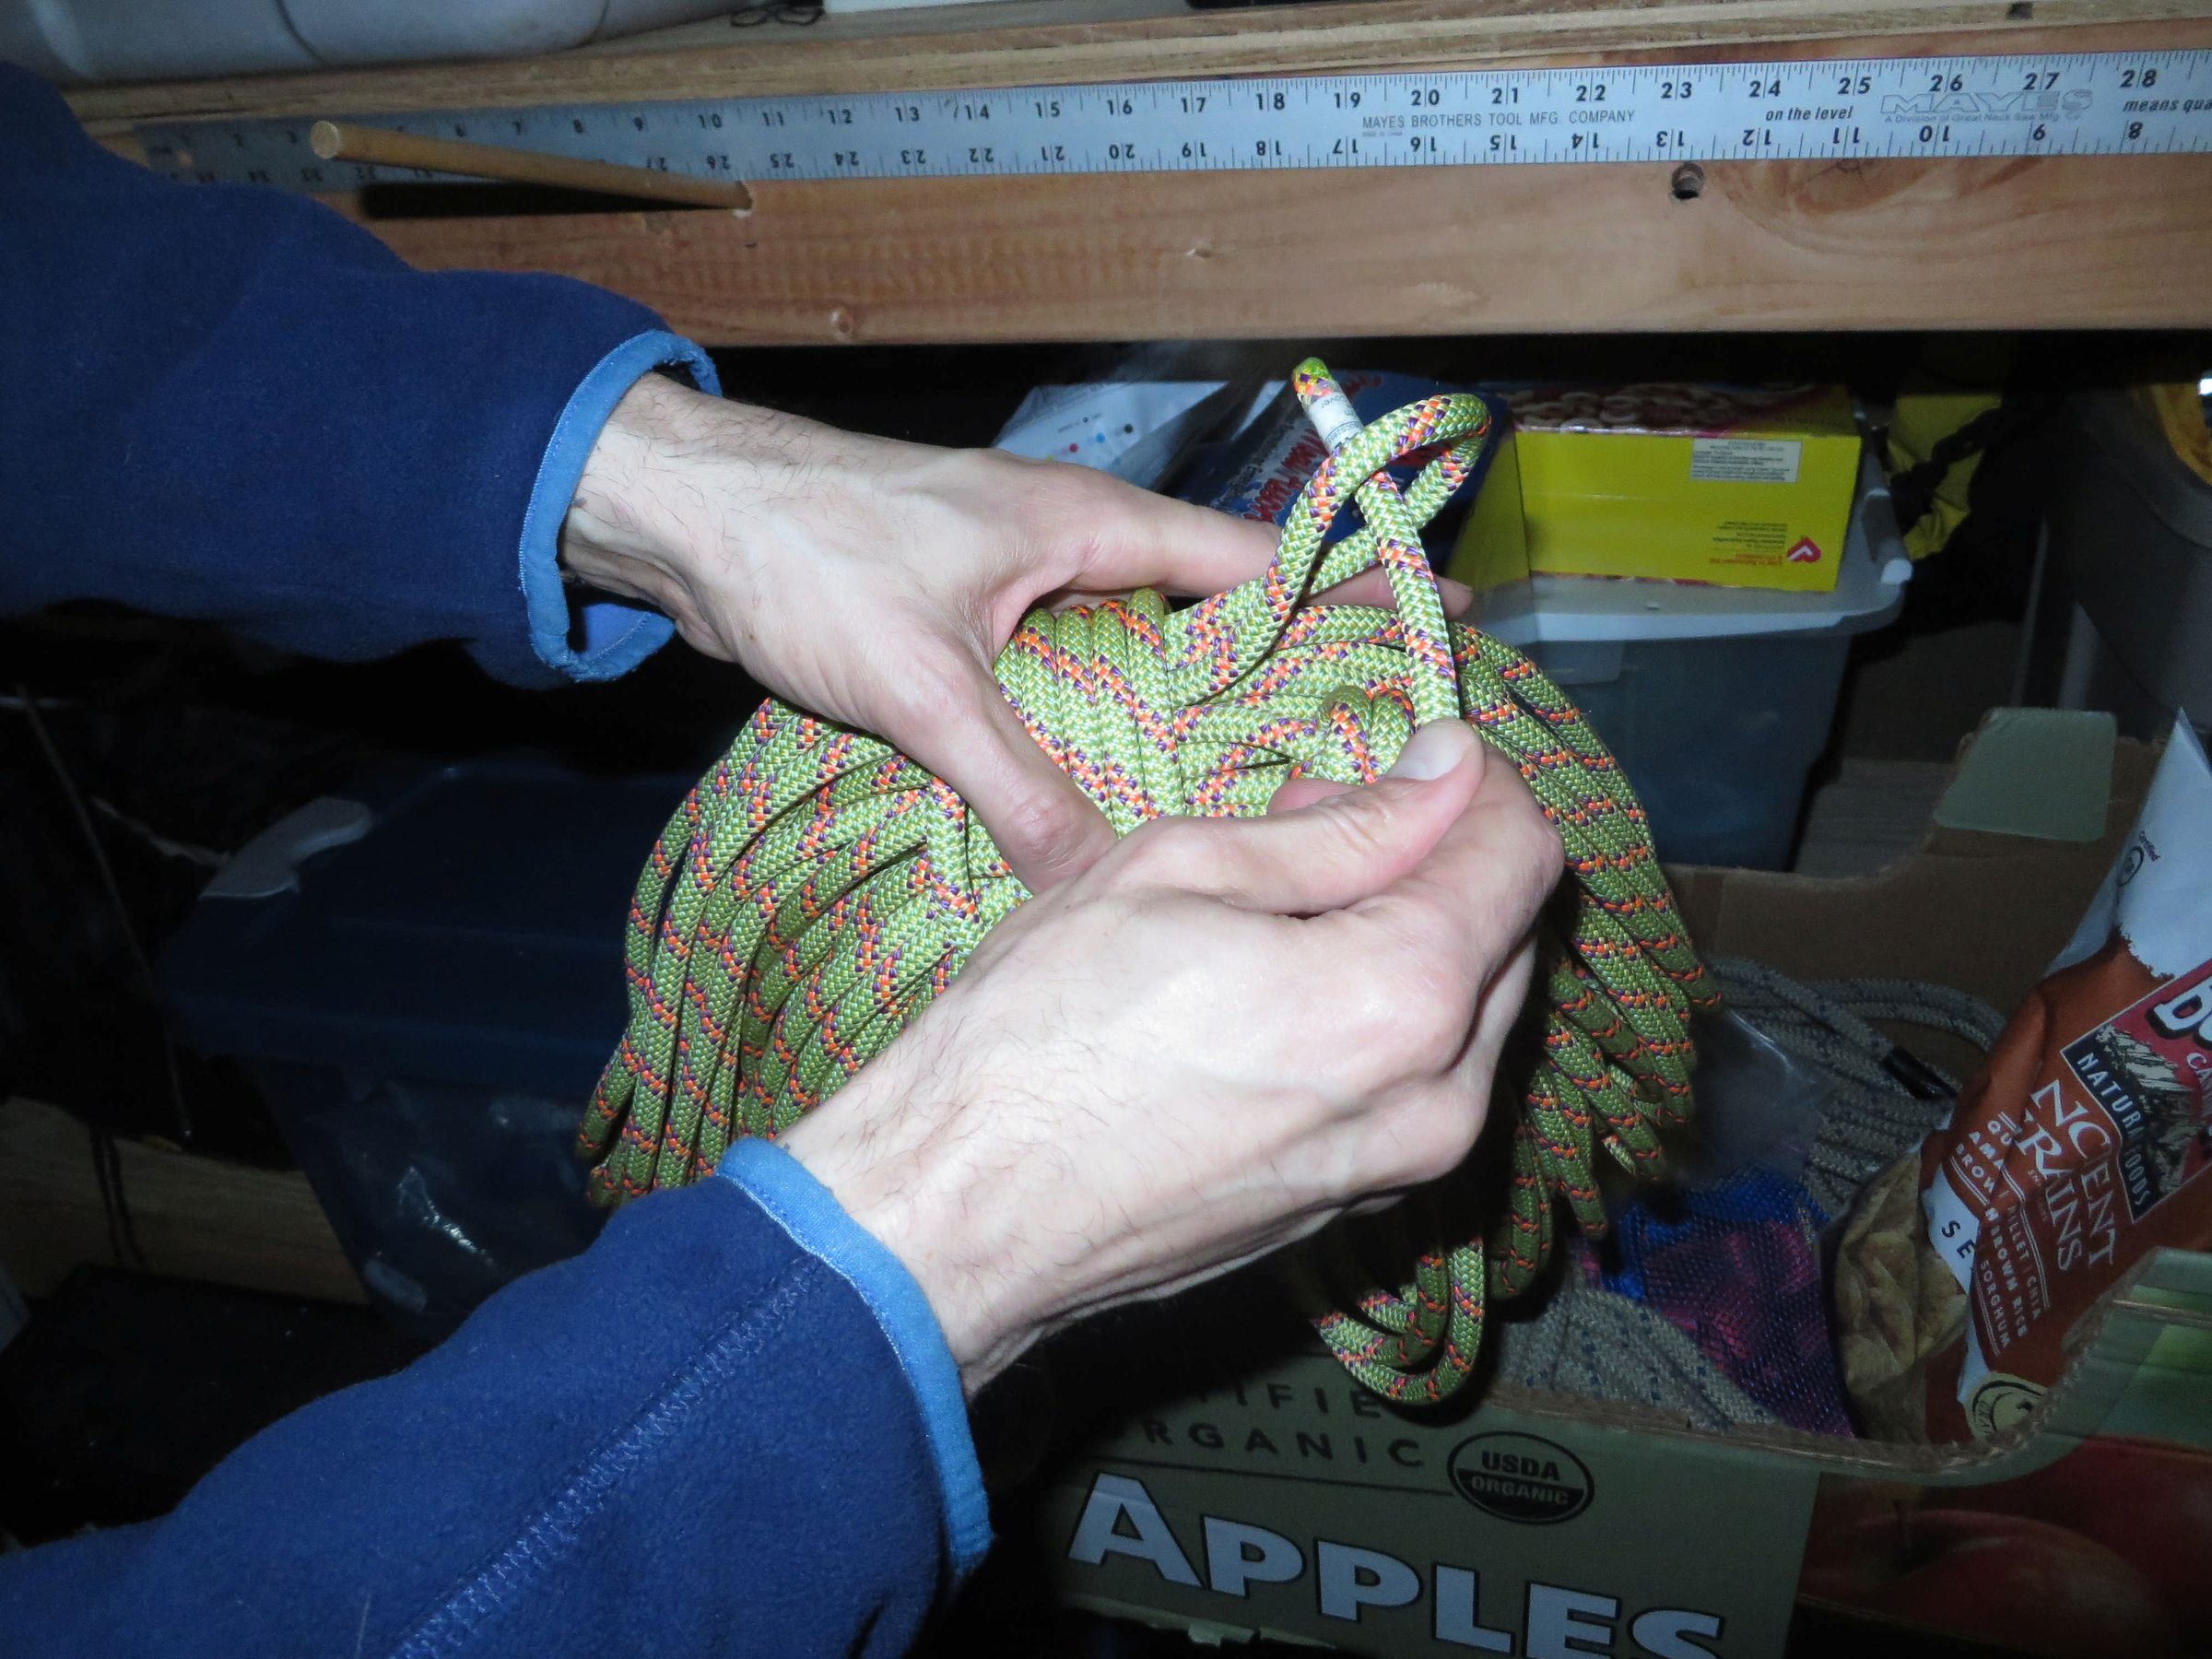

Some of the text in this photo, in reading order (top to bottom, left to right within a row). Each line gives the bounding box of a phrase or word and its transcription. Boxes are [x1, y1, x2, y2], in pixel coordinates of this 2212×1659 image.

[634, 116, 643, 131] 9
[699, 113, 722, 129] 10
[763, 111, 784, 126] 11
[830, 109, 853, 124] 12
[895, 107, 919, 122] 13
[966, 104, 989, 120] 14
[1036, 101, 1060, 118] 15
[1108, 100, 1133, 115] 16
[1181, 98, 1206, 112] 17
[1256, 93, 1285, 110] 18
[1335, 92, 1360, 108] 19
[1411, 89, 1440, 105] 20
[1492, 88, 1518, 104] 21
[1576, 85, 1606, 101] 22
[1661, 82, 1692, 99] 23
[1749, 80, 1781, 97] 24
[1839, 77, 1871, 94] 25
[1930, 74, 1963, 91] 26
[2023, 73, 2059, 90] 27
[2121, 68, 2157, 88] 28
[1362, 116, 1405, 128] MAYES
[1411, 113, 1481, 127] BROTHERS
[1489, 112, 1522, 126] TOOL
[1569, 110, 1635, 124] COMPANY
[1766, 106, 1853, 121] on the level
[1881, 89, 2093, 112] MAYES
[2124, 98, 2212, 113] means qua
[771, 153, 794, 169] 25
[834, 151, 858, 166] 24
[901, 149, 926, 164] 23
[970, 147, 994, 162] 22
[1041, 146, 1065, 160] 21
[1110, 144, 1135, 159] 20
[1182, 142, 1206, 158] 19
[1256, 140, 1281, 156] 18
[1333, 138, 1358, 154] 17
[1410, 137, 1436, 152] 16
[1490, 135, 1517, 150] 15
[1571, 133, 1598, 149] 14
[1656, 131, 1684, 147] 13
[1743, 129, 1771, 145] 12
[1833, 127, 1859, 143] 11
[1919, 125, 1950, 141] 10
[2128, 122, 2143, 139] 8
[2077, 1051, 2147, 1141] NATURA
[2014, 1108, 2083, 1271] RAINS
[1941, 1220, 1975, 1259] SE
[1956, 1143, 2011, 1347] BROW SORGHUM
[1991, 1225, 2018, 1291] BROWN
[2012, 1296, 2028, 1336] RICE
[1144, 1419, 1423, 1467] RGANIC
[1482, 1450, 1560, 1482] USDA
[1471, 1475, 1569, 1506] ORGANIC
[1066, 1472, 1727, 1659] APPLES
